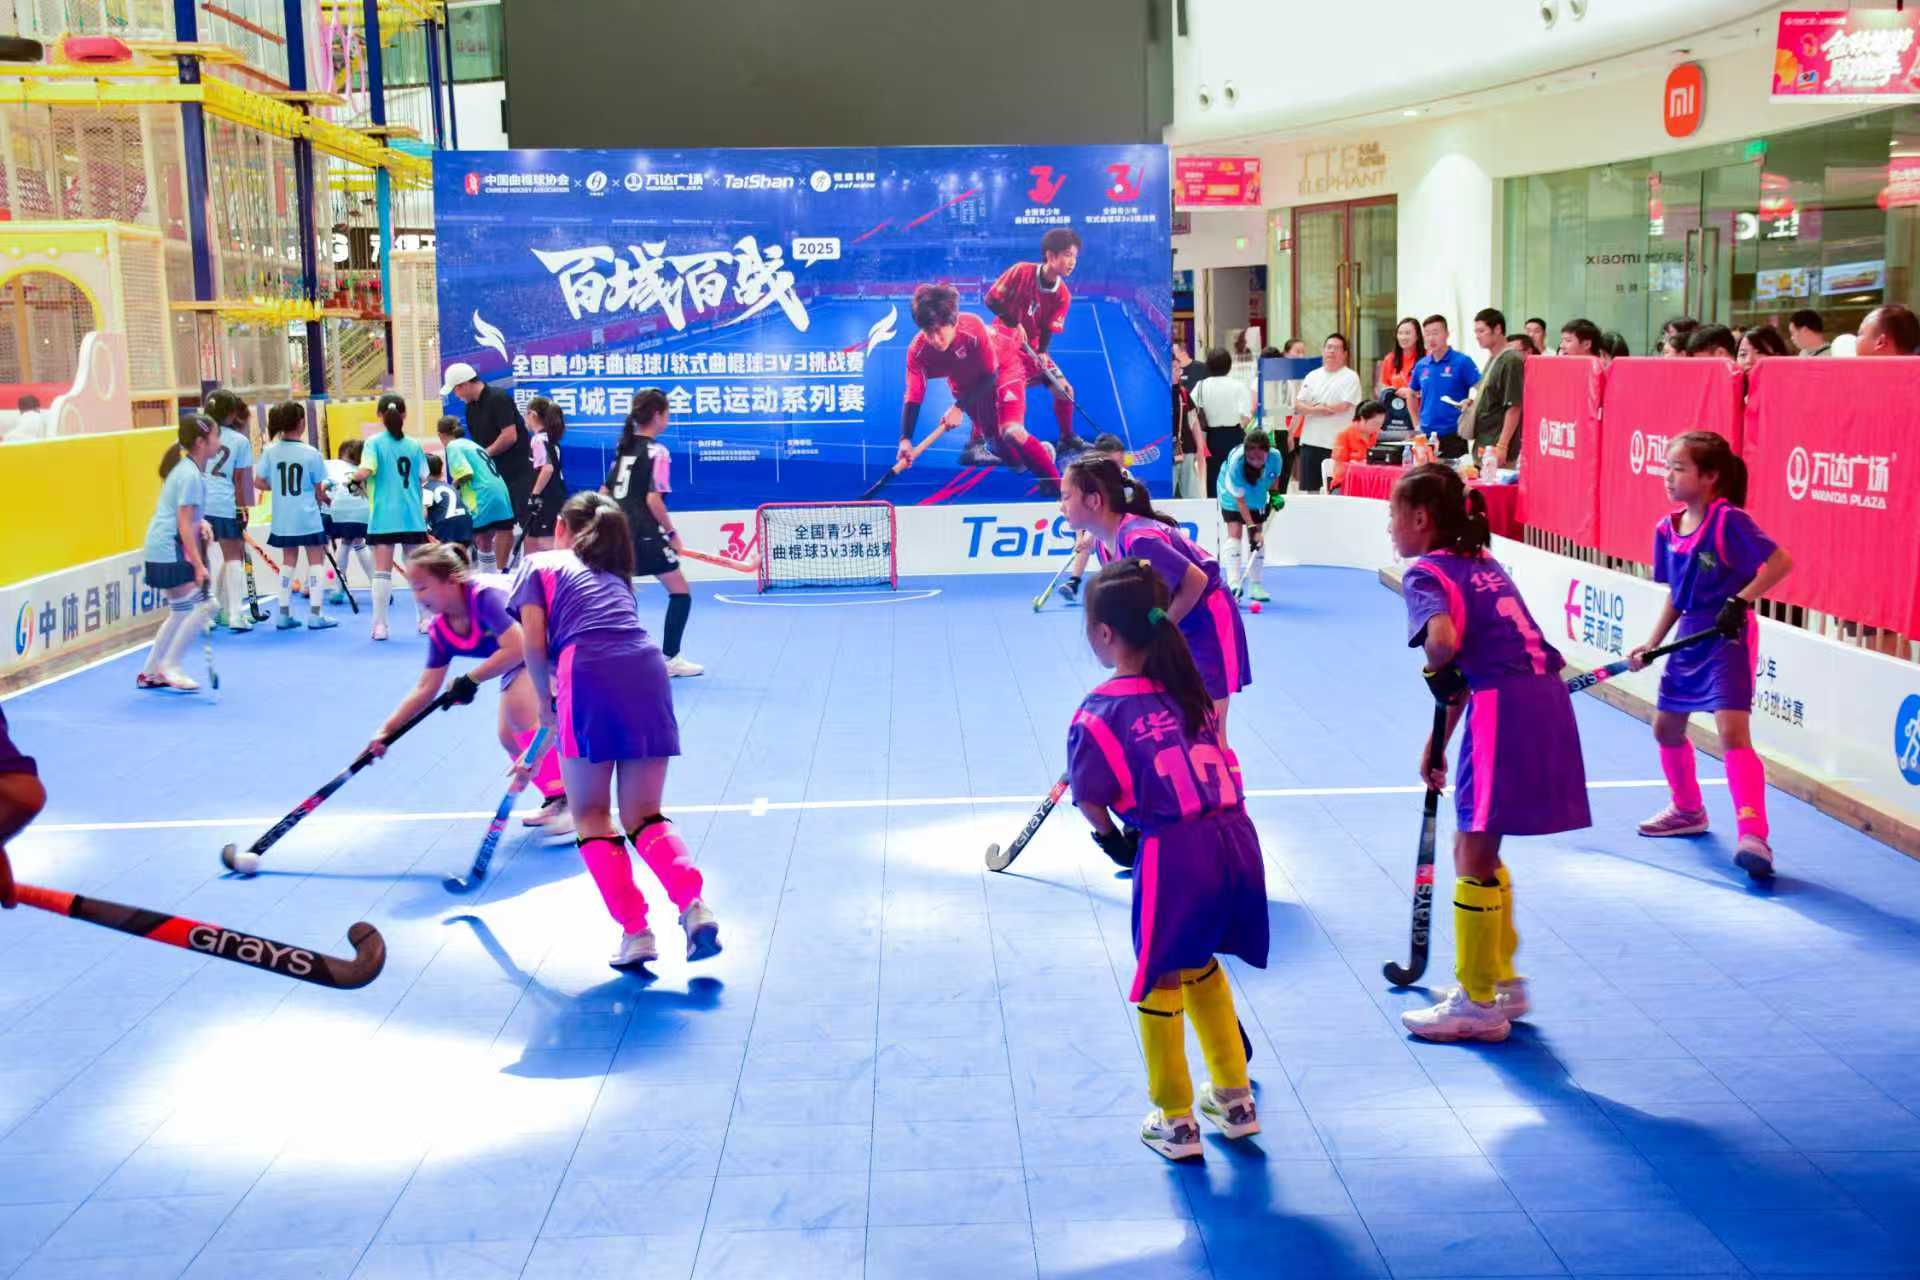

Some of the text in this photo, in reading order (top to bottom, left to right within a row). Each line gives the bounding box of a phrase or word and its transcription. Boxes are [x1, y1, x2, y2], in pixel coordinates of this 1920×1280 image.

[646, 173, 704, 186] 万达广场
[724, 174, 794, 189] TaiShan
[799, 243, 834, 255] 2025
[1585, 254, 1641, 265] xiaomi
[530, 235, 810, 333] 百城百战
[211, 445, 230, 478] 2
[397, 456, 412, 489] 9
[613, 456, 636, 499] 5
[1812, 452, 1889, 492] 万达广场
[277, 461, 303, 496] 10
[433, 484, 466, 519] 2
[1811, 489, 1887, 509] WANDA PLAZA
[795, 522, 873, 540] 全国青少年
[39, 580, 120, 649] 中体合和
[1585, 584, 1624, 621] ENLIO
